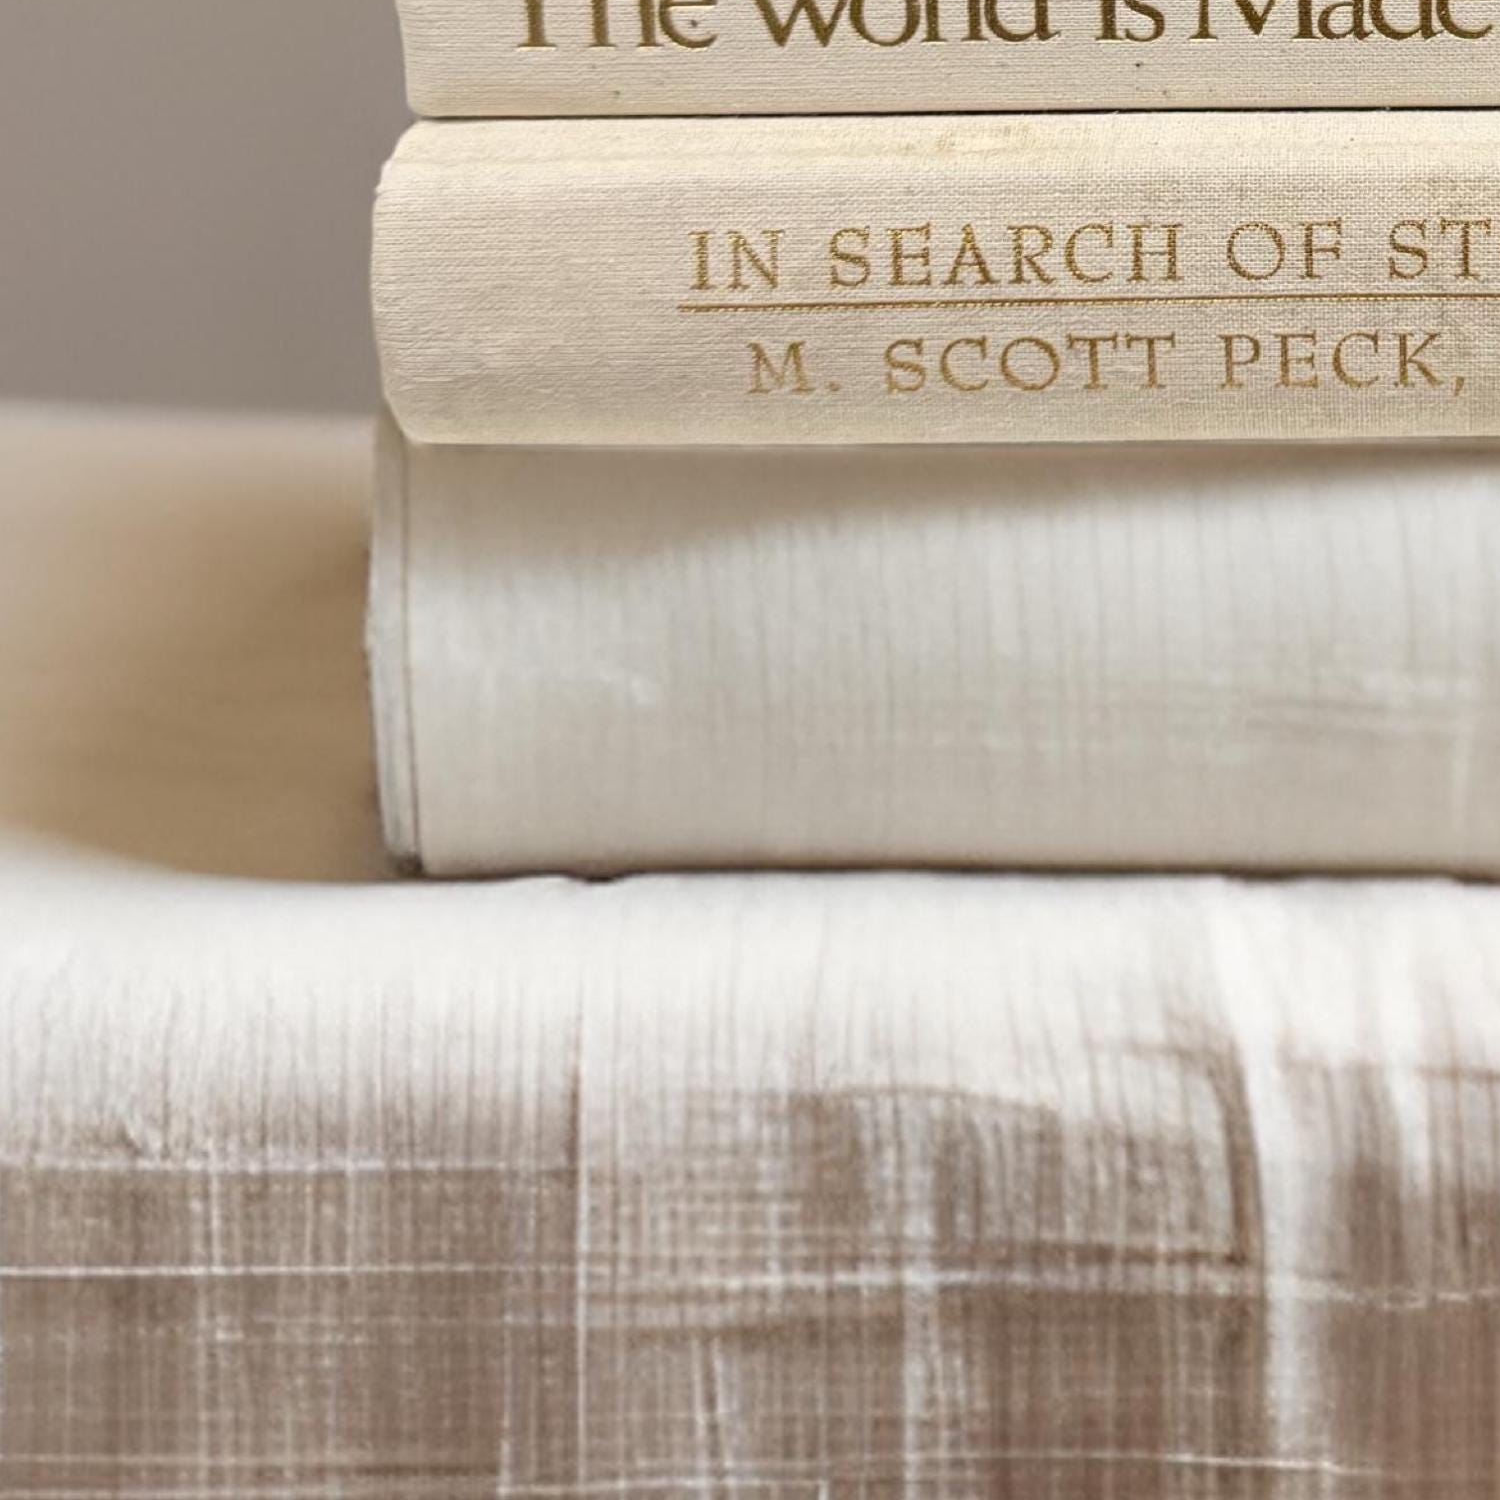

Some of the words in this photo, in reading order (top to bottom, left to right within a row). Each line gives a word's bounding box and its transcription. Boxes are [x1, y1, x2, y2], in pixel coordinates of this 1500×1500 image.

[687, 228, 787, 293] IN
[828, 221, 1186, 290] SEARCH
[1225, 216, 1344, 283] OF
[745, 340, 841, 396] M.
[882, 330, 1178, 396] SCOTT
[1219, 329, 1468, 397] PECK,
